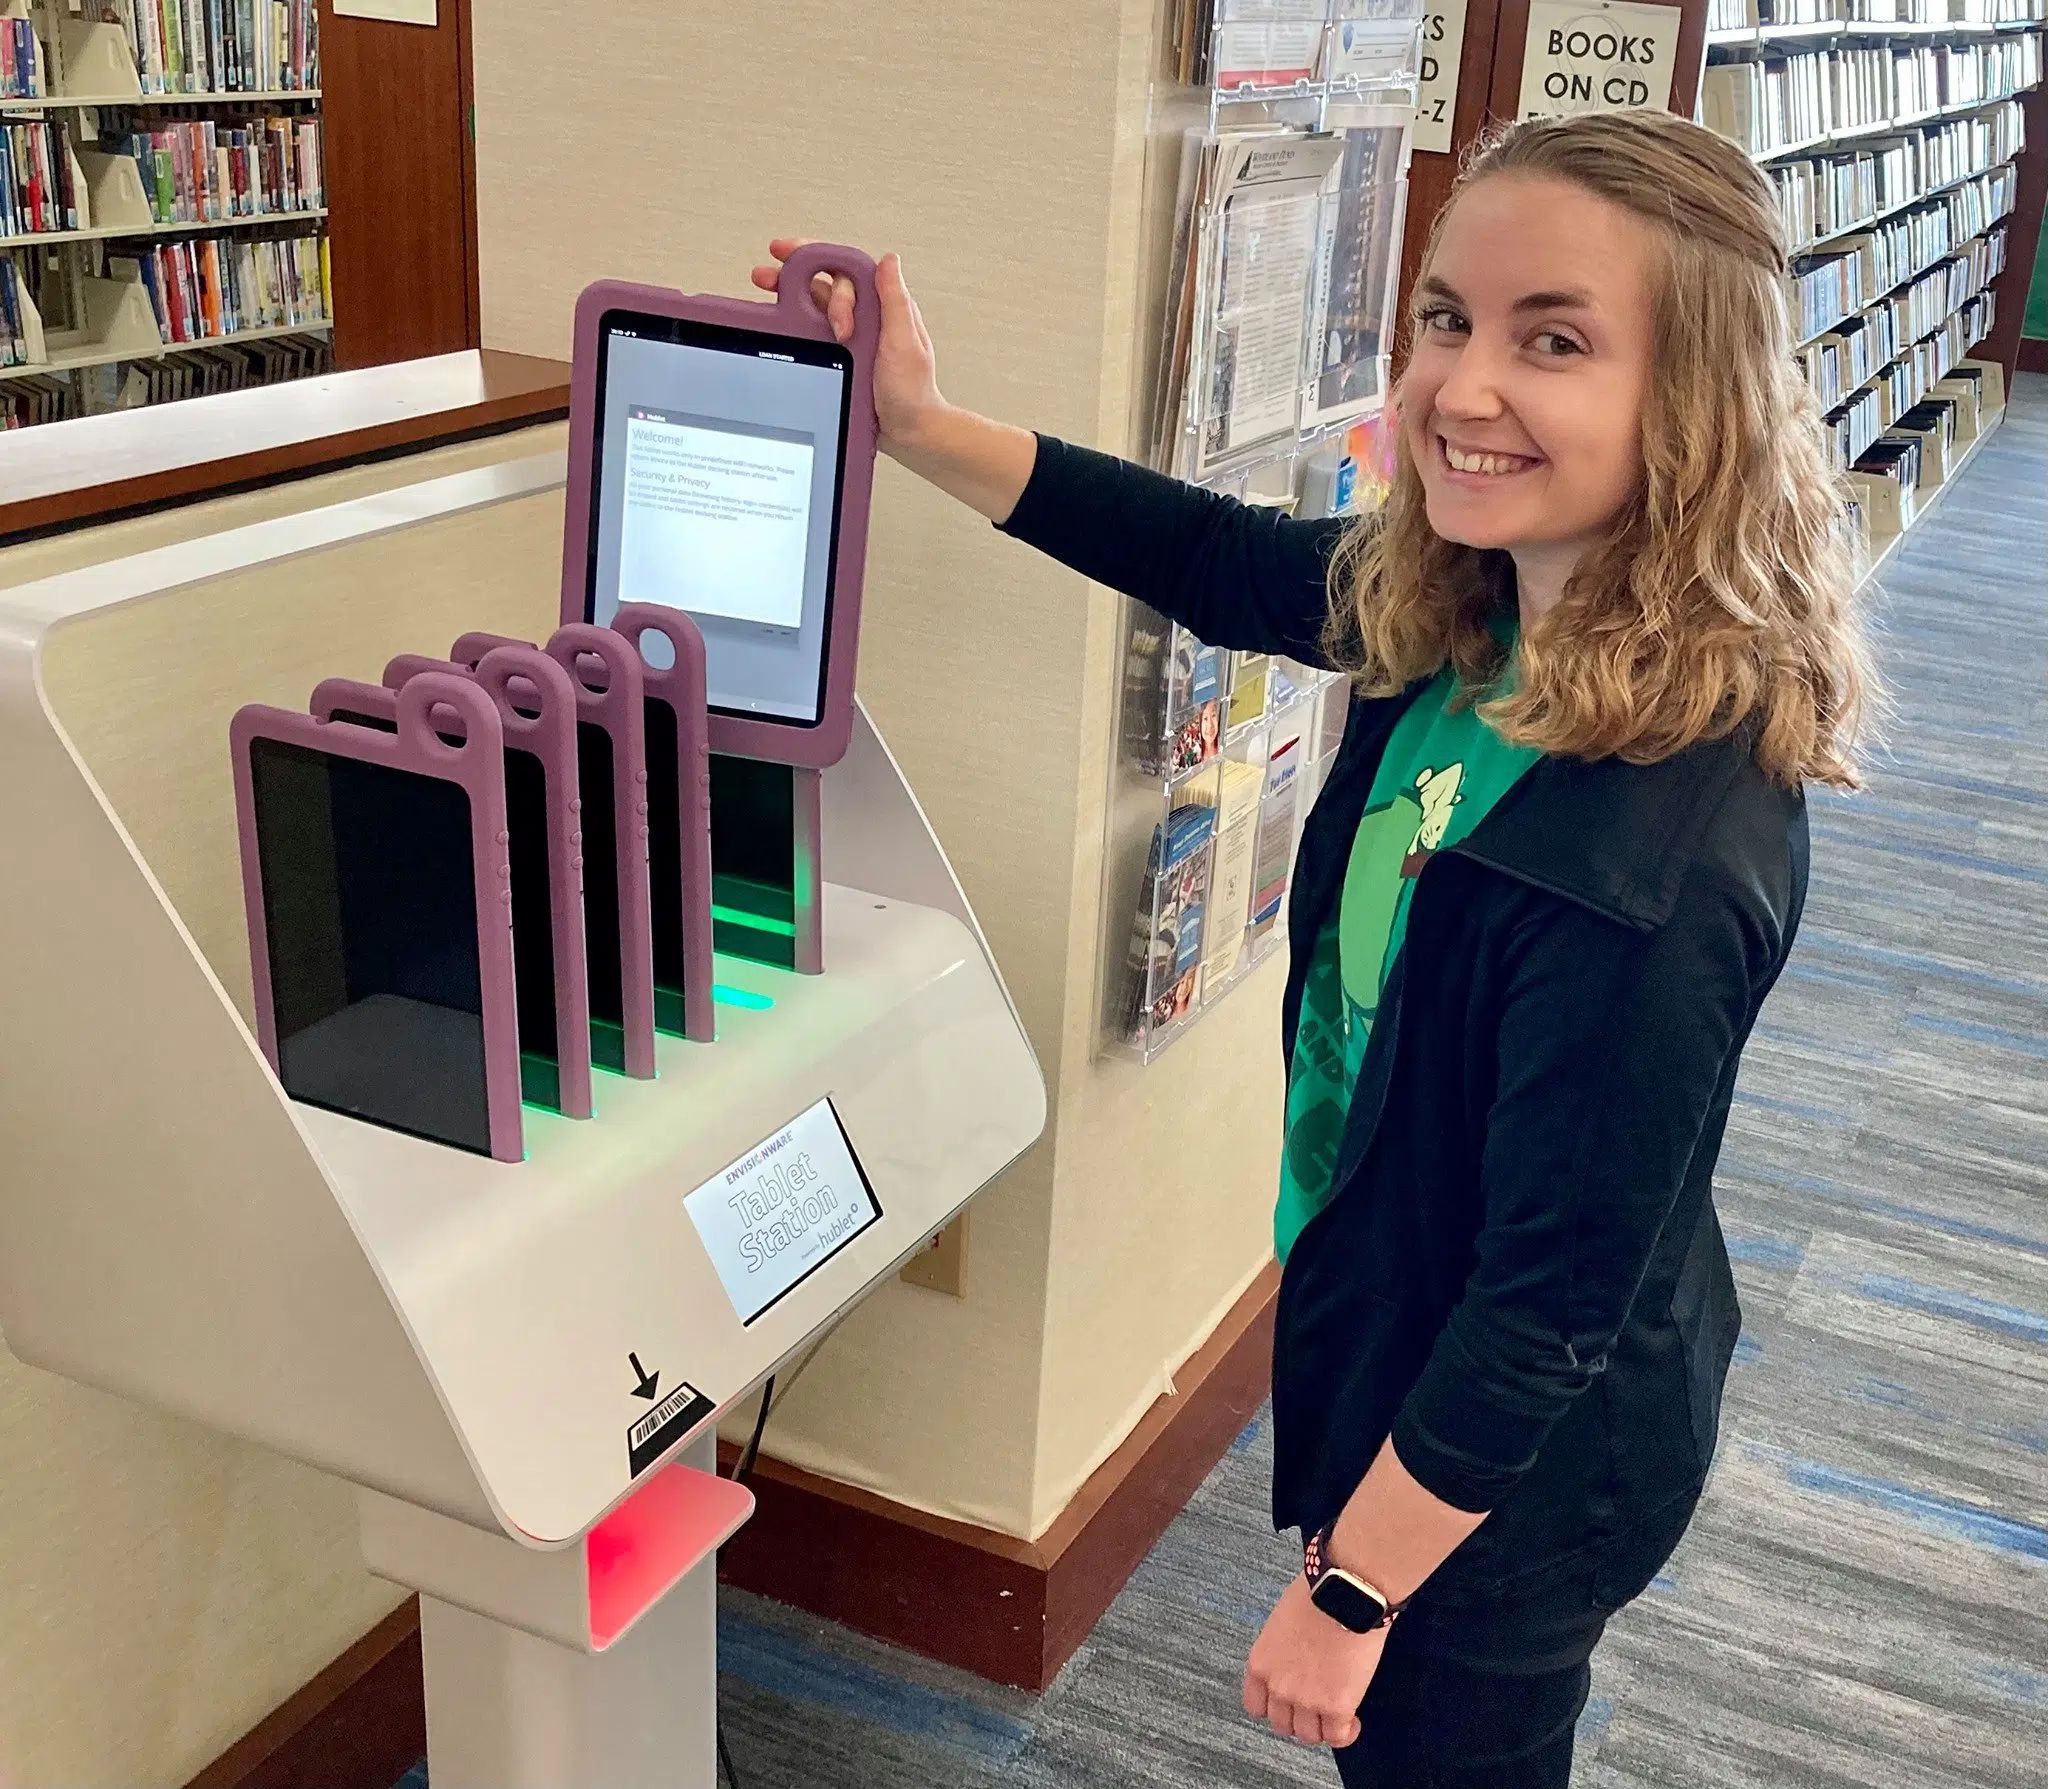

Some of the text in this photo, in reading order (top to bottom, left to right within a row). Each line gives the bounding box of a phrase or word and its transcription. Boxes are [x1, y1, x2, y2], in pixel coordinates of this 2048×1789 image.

[1548, 30, 1655, 64] BOOKS
[1544, 73, 1649, 106] ON CD
[632, 428, 684, 446] Welcome!
[630, 467, 711, 490] Security & Privacy
[725, 1130, 794, 1186] ENVISIONWARE
[728, 1152, 818, 1229] Tablet
[738, 1185, 839, 1274] Station
[818, 1211, 857, 1249] hublet
